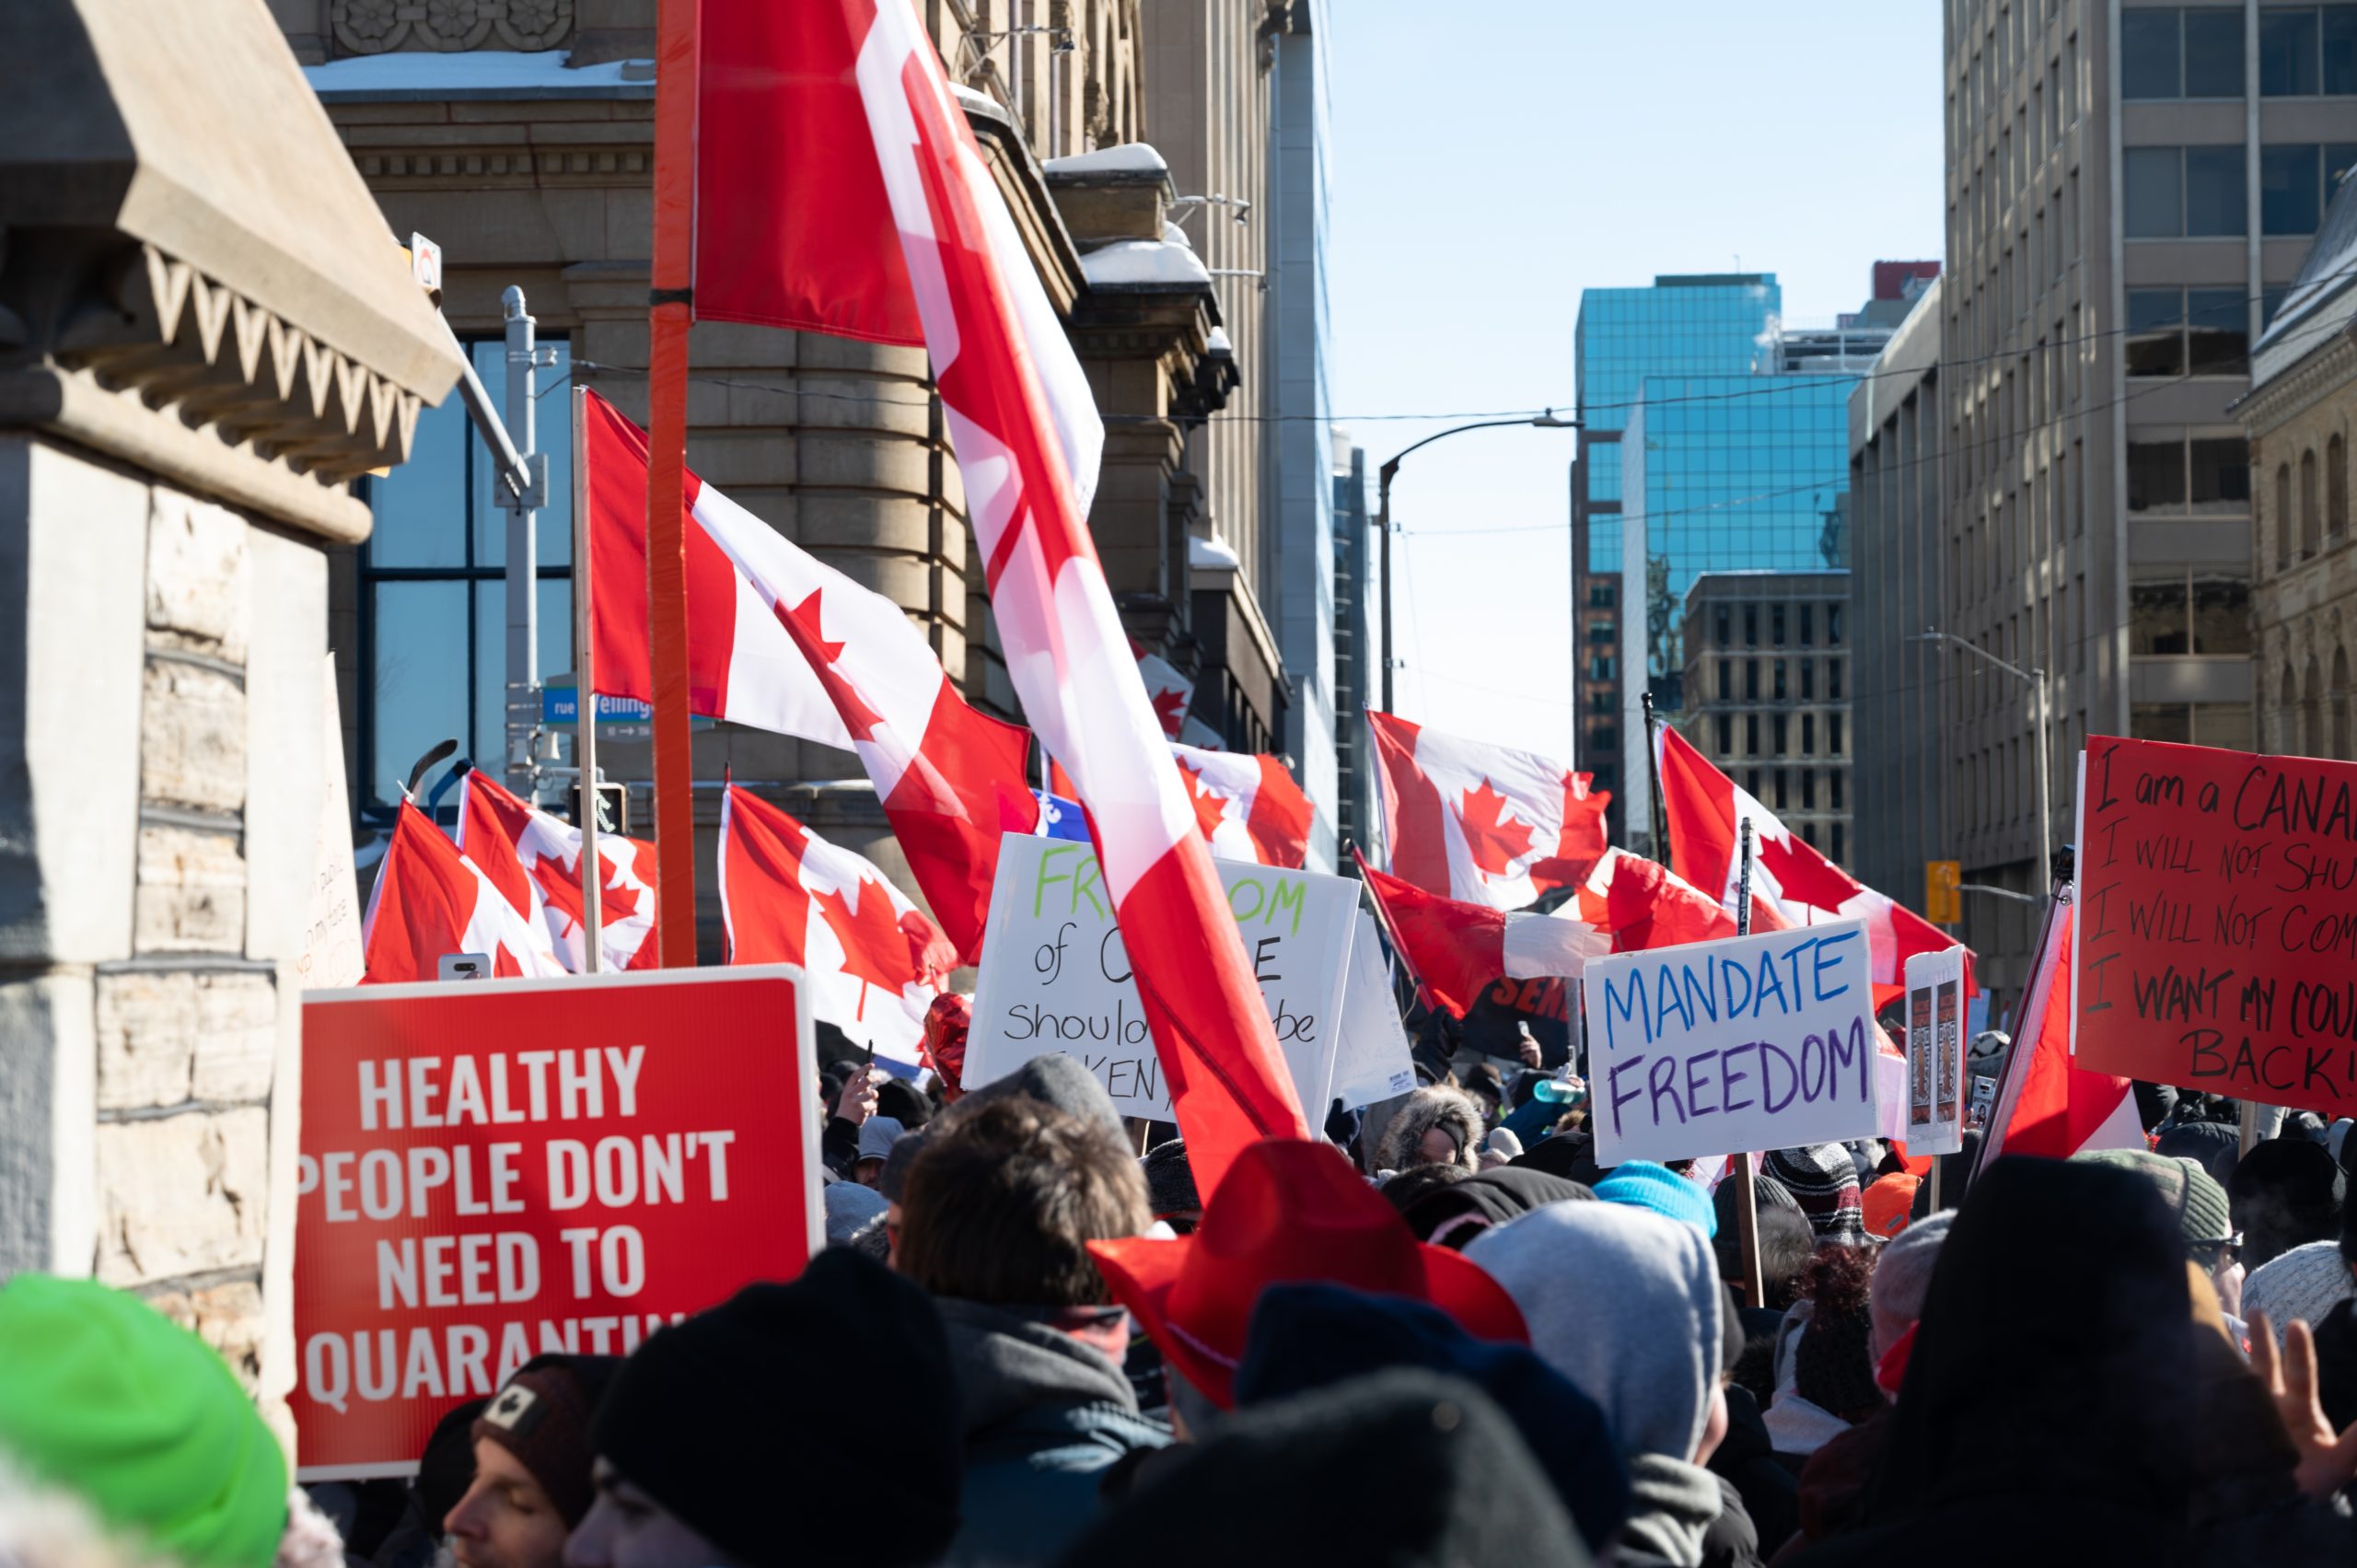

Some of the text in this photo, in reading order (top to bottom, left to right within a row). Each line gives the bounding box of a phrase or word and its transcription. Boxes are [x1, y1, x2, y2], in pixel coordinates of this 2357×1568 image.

[554, 694, 651, 719] rue elling
[2096, 744, 2357, 842] I am a CANA
[1740, 859, 1748, 922] TITAN
[2100, 817, 2130, 869] I
[2136, 833, 2201, 874] WILL
[2220, 836, 2273, 884] NOT
[1034, 923, 1078, 986] of
[2087, 882, 2121, 942] I
[2130, 889, 2201, 943] WILL
[2214, 894, 2273, 950] NOT
[1605, 930, 1860, 1050] MANDATE
[2086, 952, 2357, 1041] I WANT MY COU
[357, 1045, 646, 1132] HEALTHY
[1608, 1016, 1868, 1137] FREEDOM
[2178, 1028, 2356, 1099] BACK!
[547, 1130, 736, 1211] DON'T
[376, 1225, 646, 1311] NEED TO
